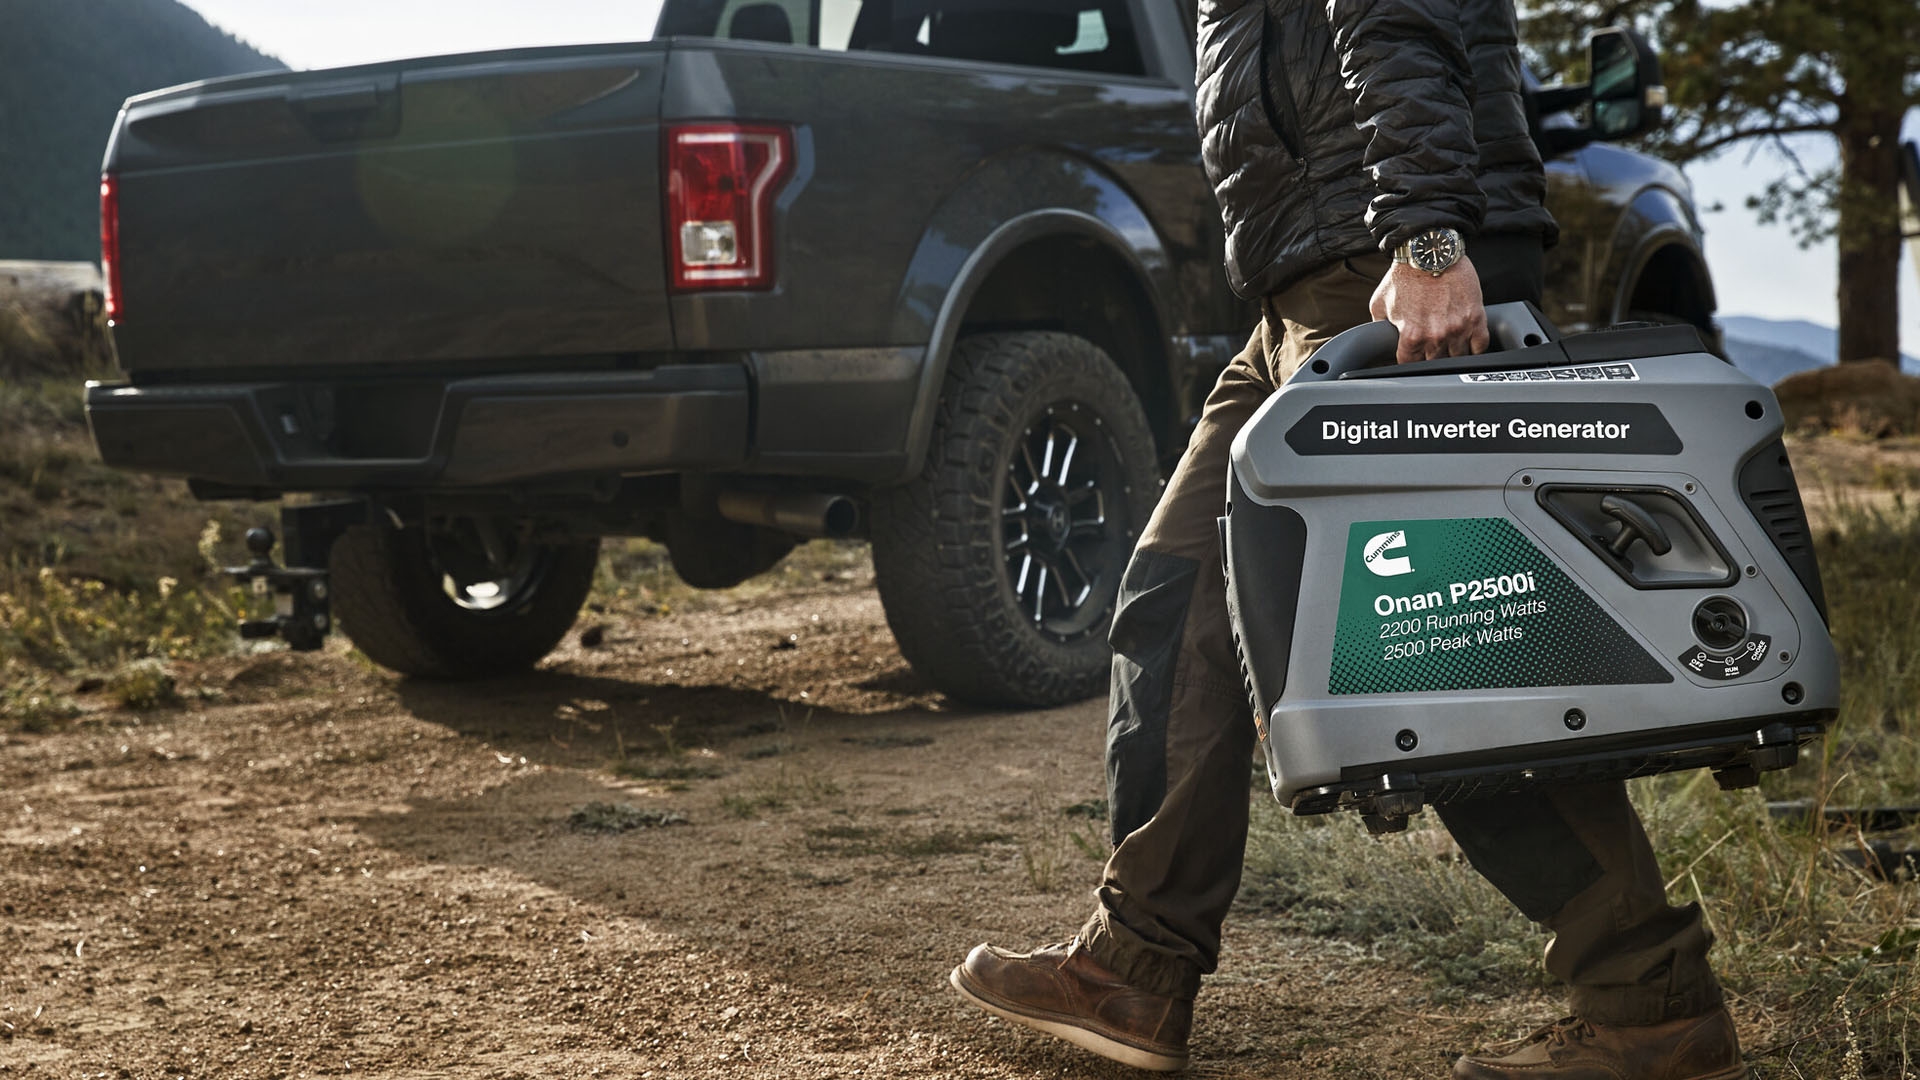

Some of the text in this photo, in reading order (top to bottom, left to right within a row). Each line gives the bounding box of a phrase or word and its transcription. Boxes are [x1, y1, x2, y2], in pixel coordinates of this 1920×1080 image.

[1322, 418, 1630, 445] Digital Inverter Generator
[1364, 530, 1401, 563] Cummins
[1374, 571, 1536, 616] Onan P2500i
[1379, 599, 1547, 639] 2200 Running Watts
[1383, 626, 1523, 661] 2500 Peak Watts
[1751, 640, 1765, 661] CHOKE
[1691, 658, 1703, 667] OFF
